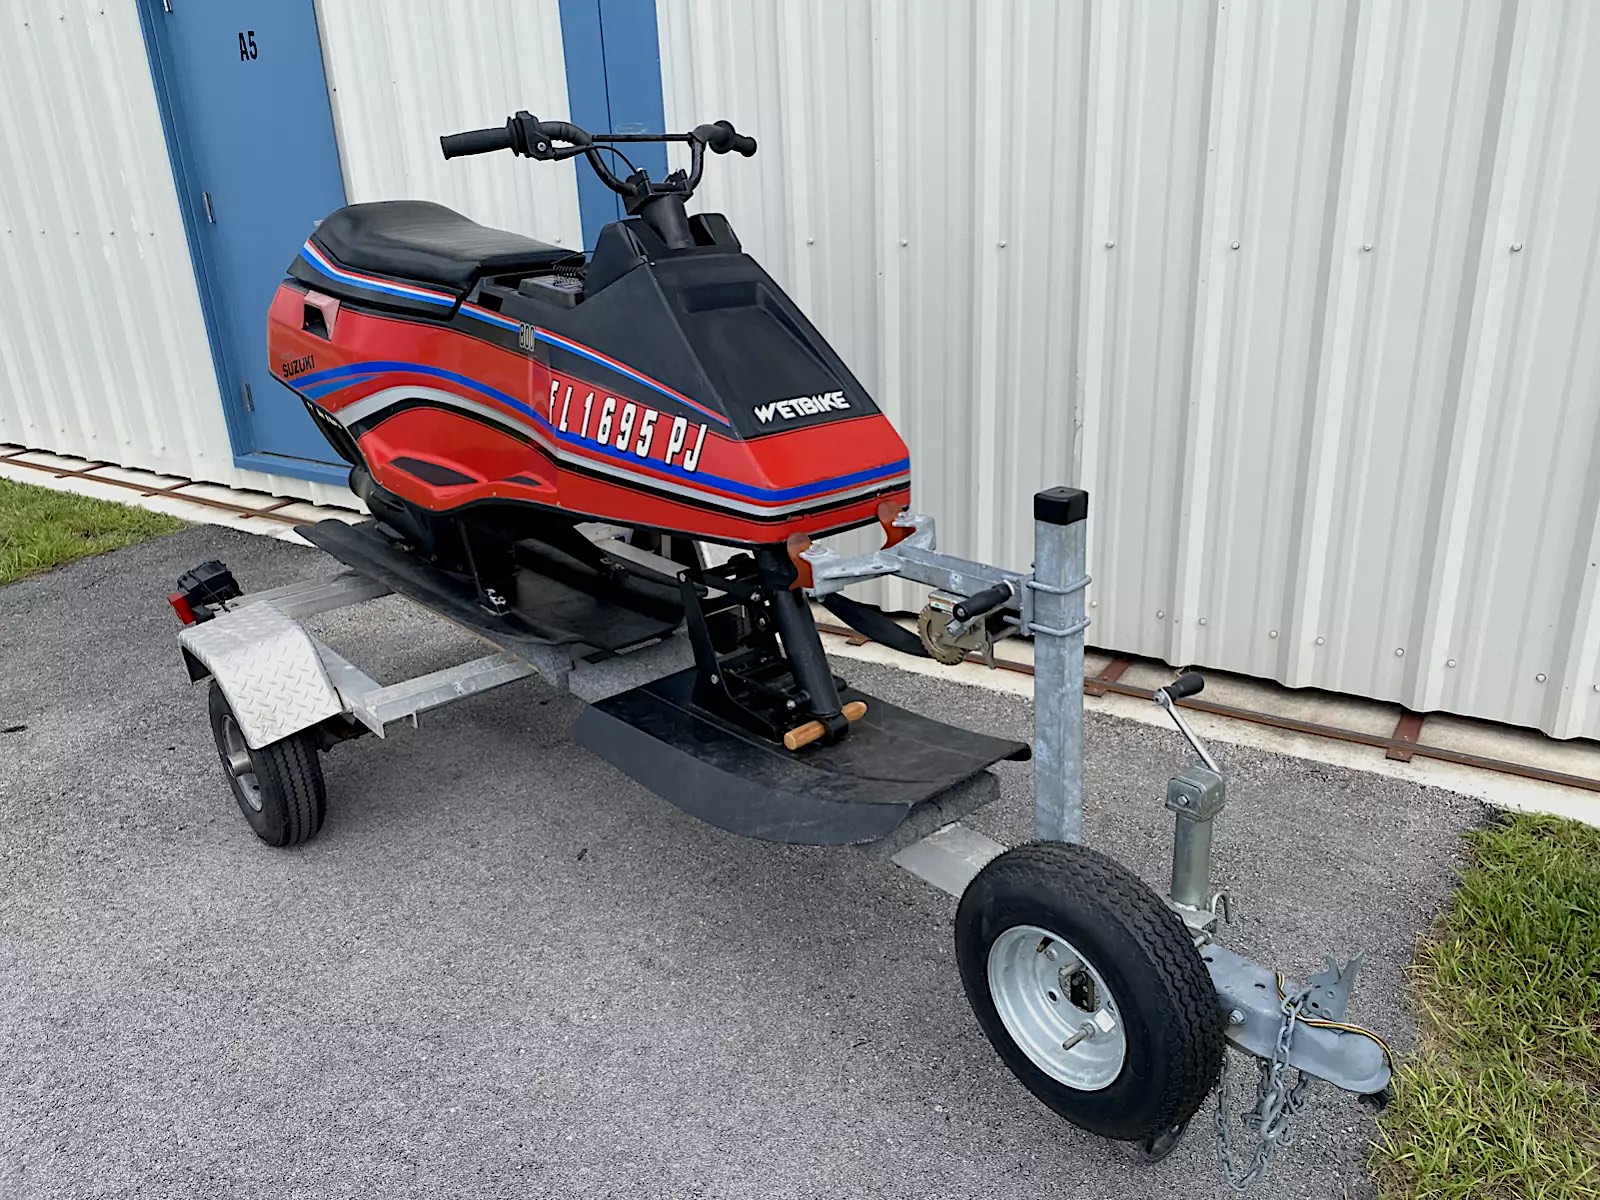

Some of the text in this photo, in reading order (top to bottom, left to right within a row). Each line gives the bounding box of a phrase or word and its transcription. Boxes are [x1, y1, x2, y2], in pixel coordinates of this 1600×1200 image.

[238, 30, 258, 62] A5
[519, 321, 536, 352] 800
[282, 354, 315, 378] SUZUKI
[753, 390, 852, 424] WETBIKE
[549, 379, 708, 472] FL 1695 PJ
